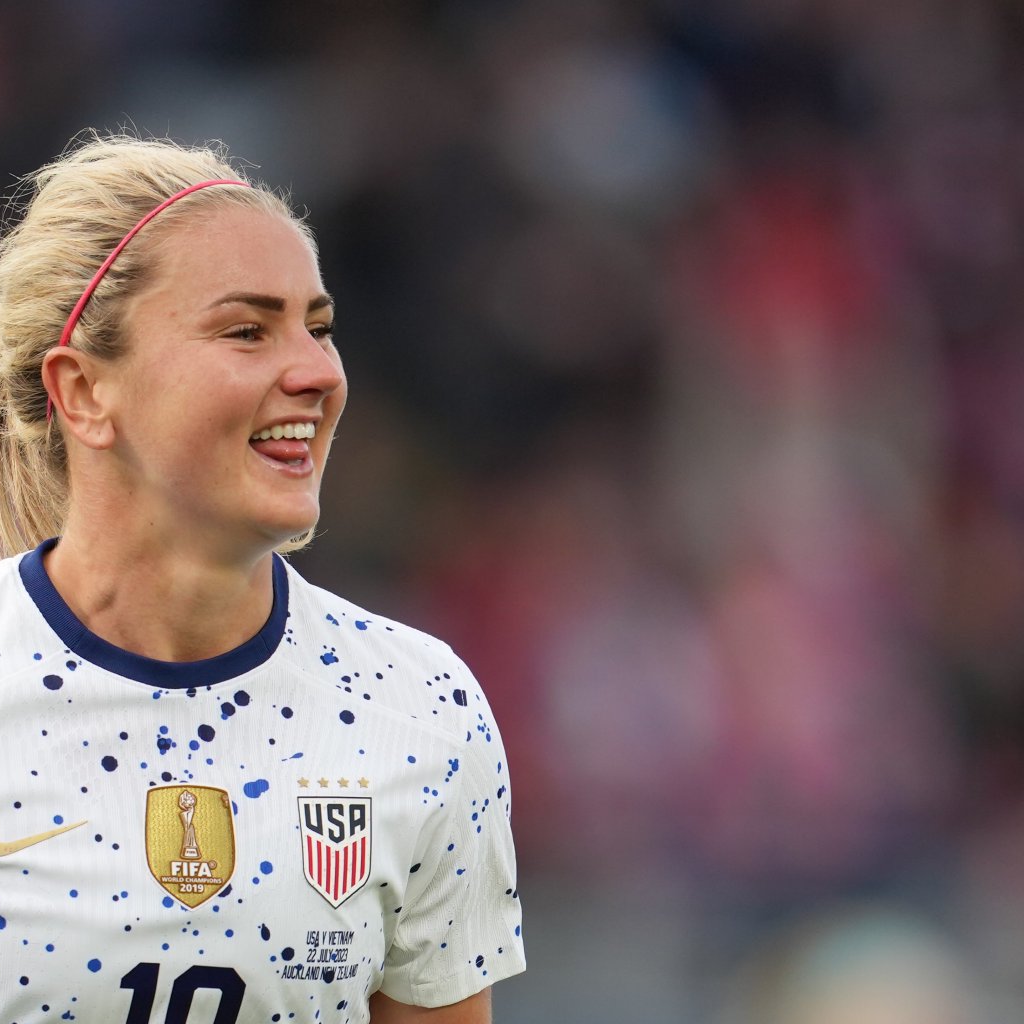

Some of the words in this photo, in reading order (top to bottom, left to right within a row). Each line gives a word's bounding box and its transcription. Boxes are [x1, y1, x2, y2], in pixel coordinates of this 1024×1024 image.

[304, 803, 366, 843] USA
[171, 861, 212, 877] FIFA
[180, 883, 205, 893] 2019
[306, 930, 319, 945] USA
[322, 931, 327, 945] V
[328, 930, 355, 945] VIETNAM
[306, 949, 317, 963] 22
[317, 948, 334, 963] JULY
[333, 948, 349, 963] 2023
[281, 965, 321, 980] AUCKLAND
[336, 964, 359, 981] ZEALAND
